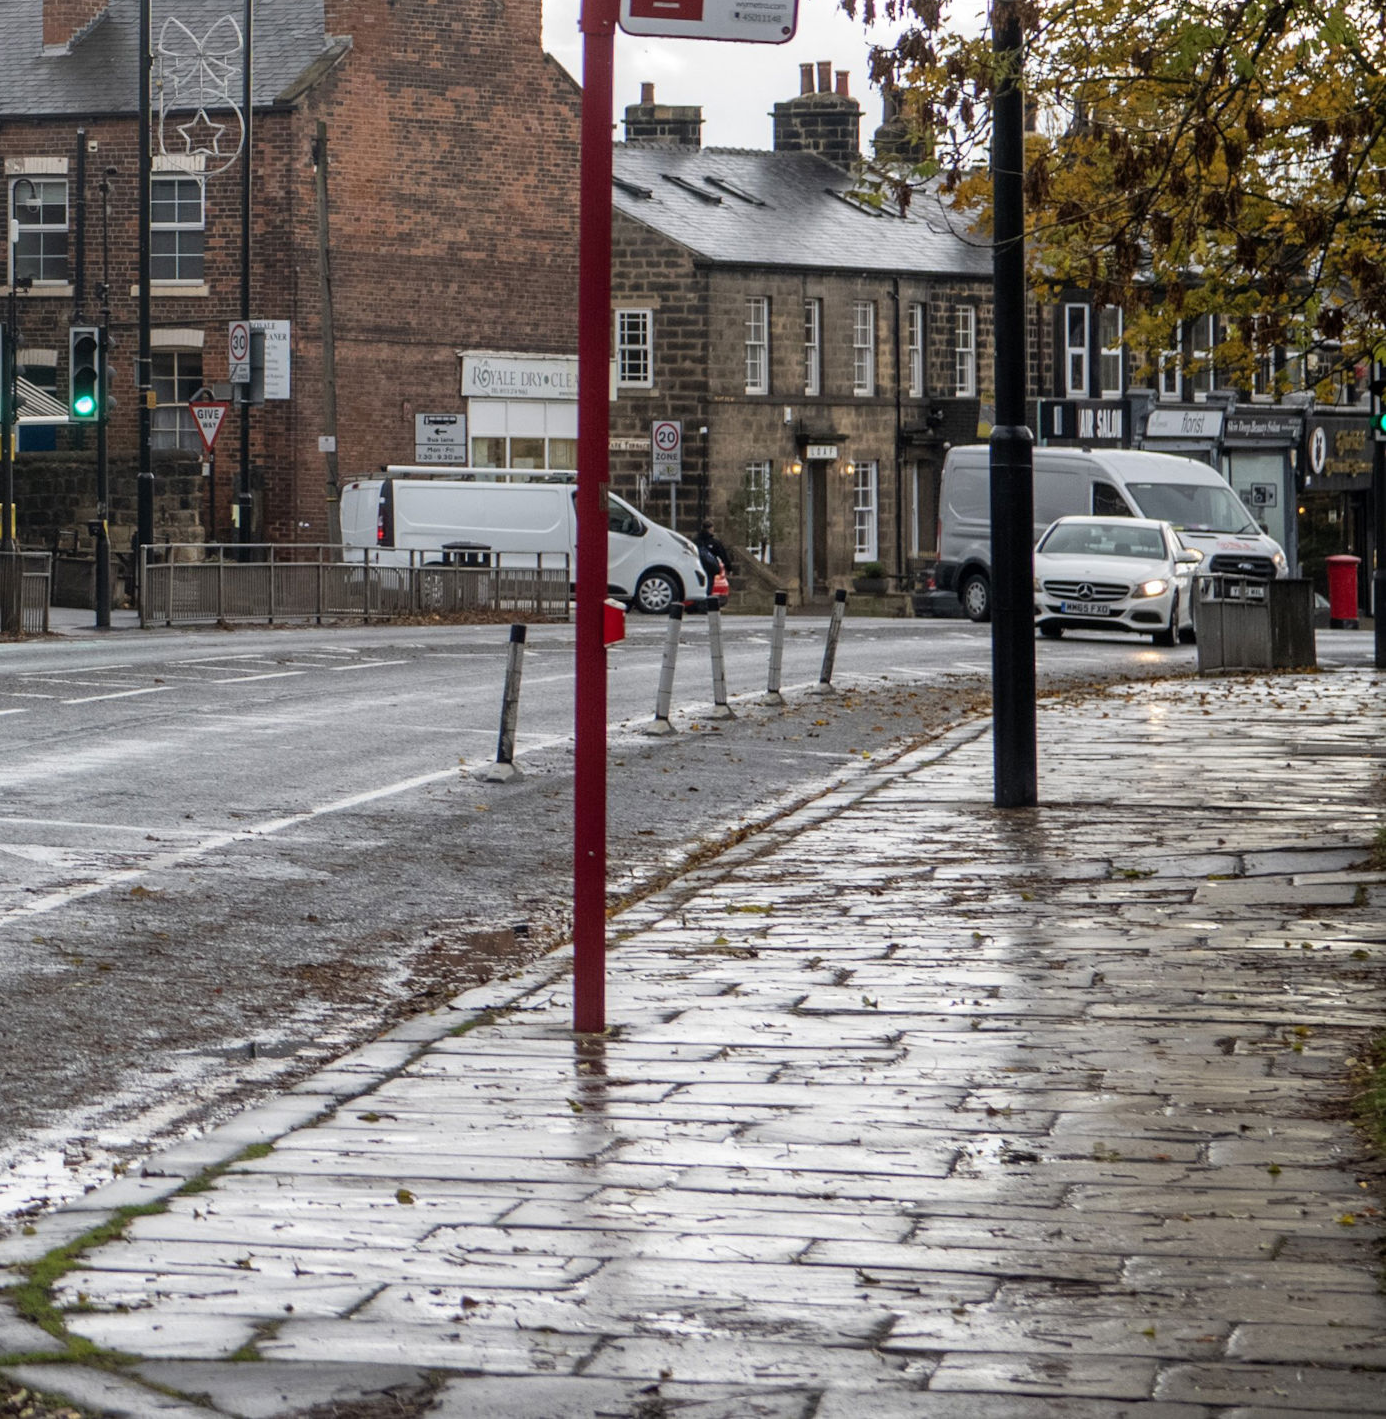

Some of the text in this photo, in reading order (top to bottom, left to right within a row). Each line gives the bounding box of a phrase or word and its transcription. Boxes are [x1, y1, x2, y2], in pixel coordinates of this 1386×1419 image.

[232, 335, 246, 350] 30
[472, 365, 579, 388] ROYALE DRY CLE
[197, 409, 220, 420] GIVE
[1096, 408, 1123, 439] SALON
[1180, 411, 1206, 434] florist
[658, 431, 676, 444] 20
[655, 452, 678, 461] ZONE
